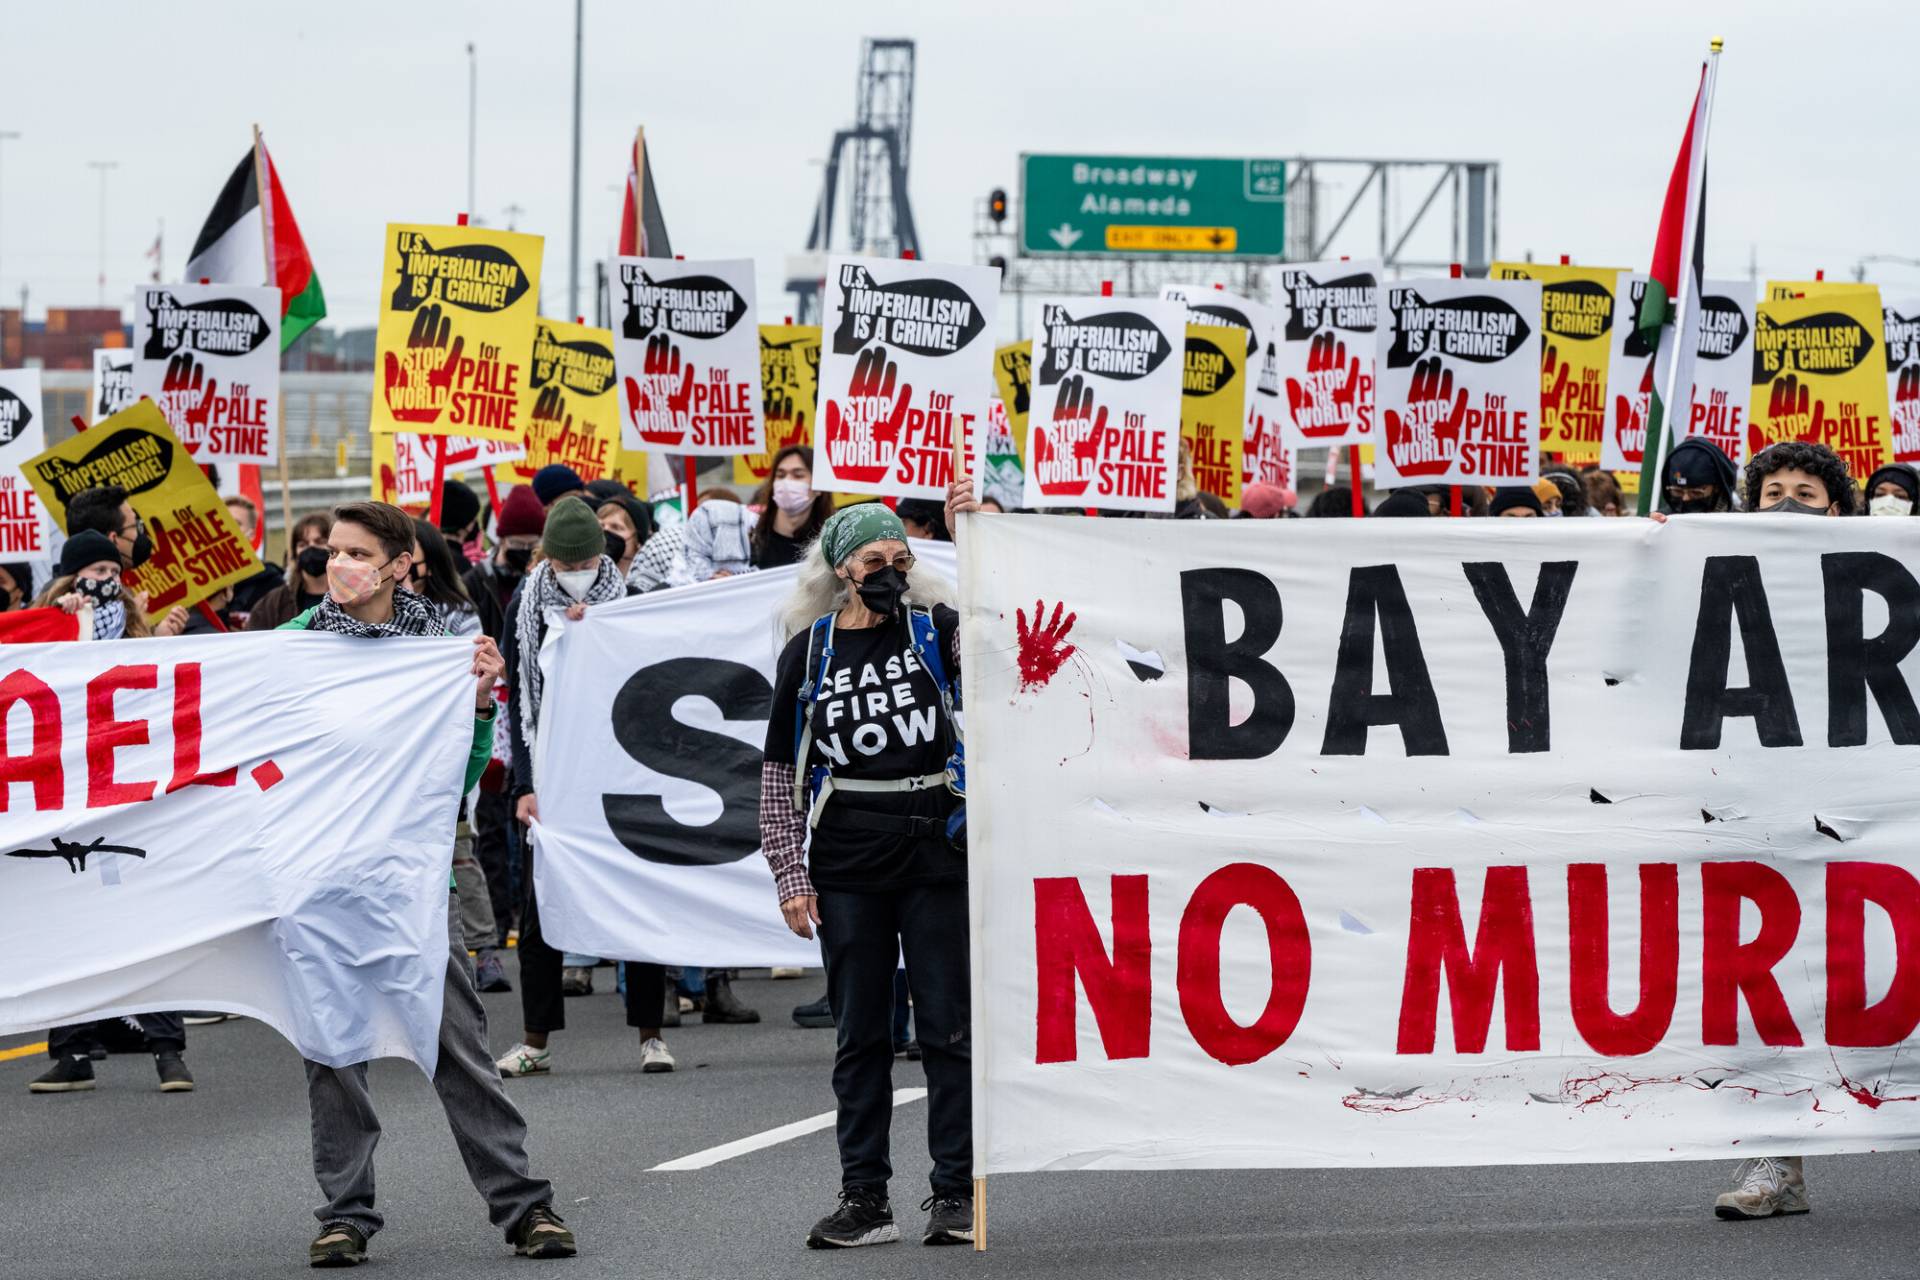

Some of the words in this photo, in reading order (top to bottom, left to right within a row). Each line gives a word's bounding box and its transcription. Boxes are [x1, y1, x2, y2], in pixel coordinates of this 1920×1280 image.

[1073, 163, 1197, 189] Broadway
[1254, 177, 1280, 193] 42
[1081, 194, 1191, 216] Alameda
[400, 233, 426, 254] U.S.
[1152, 233, 1195, 243] ONLY
[407, 253, 517, 288] IMPERIALISM
[622, 265, 648, 285] U.S.
[842, 265, 869, 289] U.S.
[1285, 272, 1312, 289] U.S.
[148, 292, 175, 309] U.S.
[412, 277, 428, 298] IS
[431, 279, 443, 301] A
[446, 281, 507, 308] CRIME!
[633, 285, 734, 312] IMPERIALISM
[1296, 287, 1377, 309] IMPERIALIS
[1391, 289, 1419, 309] U.S.
[1542, 292, 1610, 316] ERIALISM
[640, 307, 653, 328] IS
[657, 308, 668, 329] A
[672, 309, 727, 333] CRIME!
[849, 289, 971, 327] IMPERIALISM
[1047, 305, 1067, 325] U.S.
[1303, 307, 1318, 328] IS
[1323, 307, 1334, 327] A
[1338, 306, 1377, 327] CRIME
[157, 309, 259, 334] IMPERIALISM
[854, 314, 870, 339] IS
[875, 316, 887, 341] A
[892, 319, 958, 350] CRIME!
[1402, 308, 1517, 336] IMPERIALISM
[1552, 312, 1603, 336] CRIME!
[163, 329, 178, 348] IS
[183, 329, 193, 349] A
[197, 330, 251, 352] CRIME!
[1051, 325, 1158, 353] IMPERIALISM
[1408, 331, 1424, 353] IS
[1428, 330, 1441, 352] A
[1446, 331, 1507, 357] CRIME!
[1755, 325, 1861, 351] IMPERIALISM
[404, 347, 446, 370] STOP
[480, 342, 501, 361] for
[535, 340, 614, 378] IMPERIALISM
[1055, 349, 1070, 370] IS
[1072, 349, 1083, 370] A
[1087, 350, 1148, 374] CRIME!
[1764, 350, 1779, 371] IS
[1785, 349, 1795, 369] A
[1800, 348, 1855, 369] CRIME!
[1891, 342, 1905, 361] IS
[407, 366, 430, 387] THE
[458, 357, 519, 397] PALE
[564, 367, 606, 393] CRIME!
[643, 373, 680, 396] STOP
[709, 367, 730, 383] for
[1183, 371, 1216, 392] IME!
[1306, 369, 1345, 392] STOP
[1584, 366, 1600, 383] for
[160, 389, 200, 411] STOP
[231, 382, 250, 397] for
[390, 386, 447, 410] WORLD
[694, 384, 751, 414] PALE
[930, 390, 954, 410] for
[1313, 389, 1334, 408] THE
[1485, 392, 1507, 409] for
[1566, 382, 1607, 411] PAL
[1711, 388, 1727, 403] for
[214, 397, 268, 427] PALE
[450, 392, 518, 431] STINE
[650, 394, 670, 412] THE
[845, 396, 892, 422] STOP
[1406, 400, 1450, 424] STOP
[1839, 401, 1859, 417] for
[1895, 400, 1920, 421] STO
[635, 410, 687, 432] WORLD
[1125, 410, 1146, 428] for
[1296, 403, 1350, 429] WORLD
[1466, 409, 1527, 443] PALE
[1560, 412, 1605, 442] STIN
[1690, 403, 1741, 436] PALE
[1768, 413, 1809, 439] STOP
[174, 422, 205, 444] RLD
[691, 416, 755, 446] STINE
[849, 422, 873, 442] THE
[1051, 418, 1090, 442] STOP
[1197, 421, 1215, 437] for
[1411, 423, 1434, 442] THE
[1823, 416, 1881, 448] PALE
[208, 427, 268, 456] STINE
[566, 432, 609, 465] PALE
[831, 440, 894, 467] WORLD
[1053, 442, 1075, 460] THE
[1104, 428, 1165, 463] PALE
[1392, 438, 1453, 466] WORLD
[40, 456, 71, 480] U.S.
[59, 436, 162, 495] IMPERIALISM
[1039, 460, 1094, 484] WORLD
[1460, 443, 1530, 477] STINE
[1838, 448, 1884, 479] TINE
[1098, 463, 1167, 499] STINE
[0, 491, 36, 520] ALE
[173, 505, 195, 525] for
[167, 509, 232, 559] PALE
[183, 537, 252, 586] STINE
[1180, 560, 1578, 761] BAY
[1680, 551, 1920, 750] AR
[817, 649, 921, 701] CEASE
[827, 682, 916, 727] FIRE
[816, 705, 937, 768] NOW
[1034, 862, 1313, 1066] NO
[1397, 860, 1920, 1057] MURD
